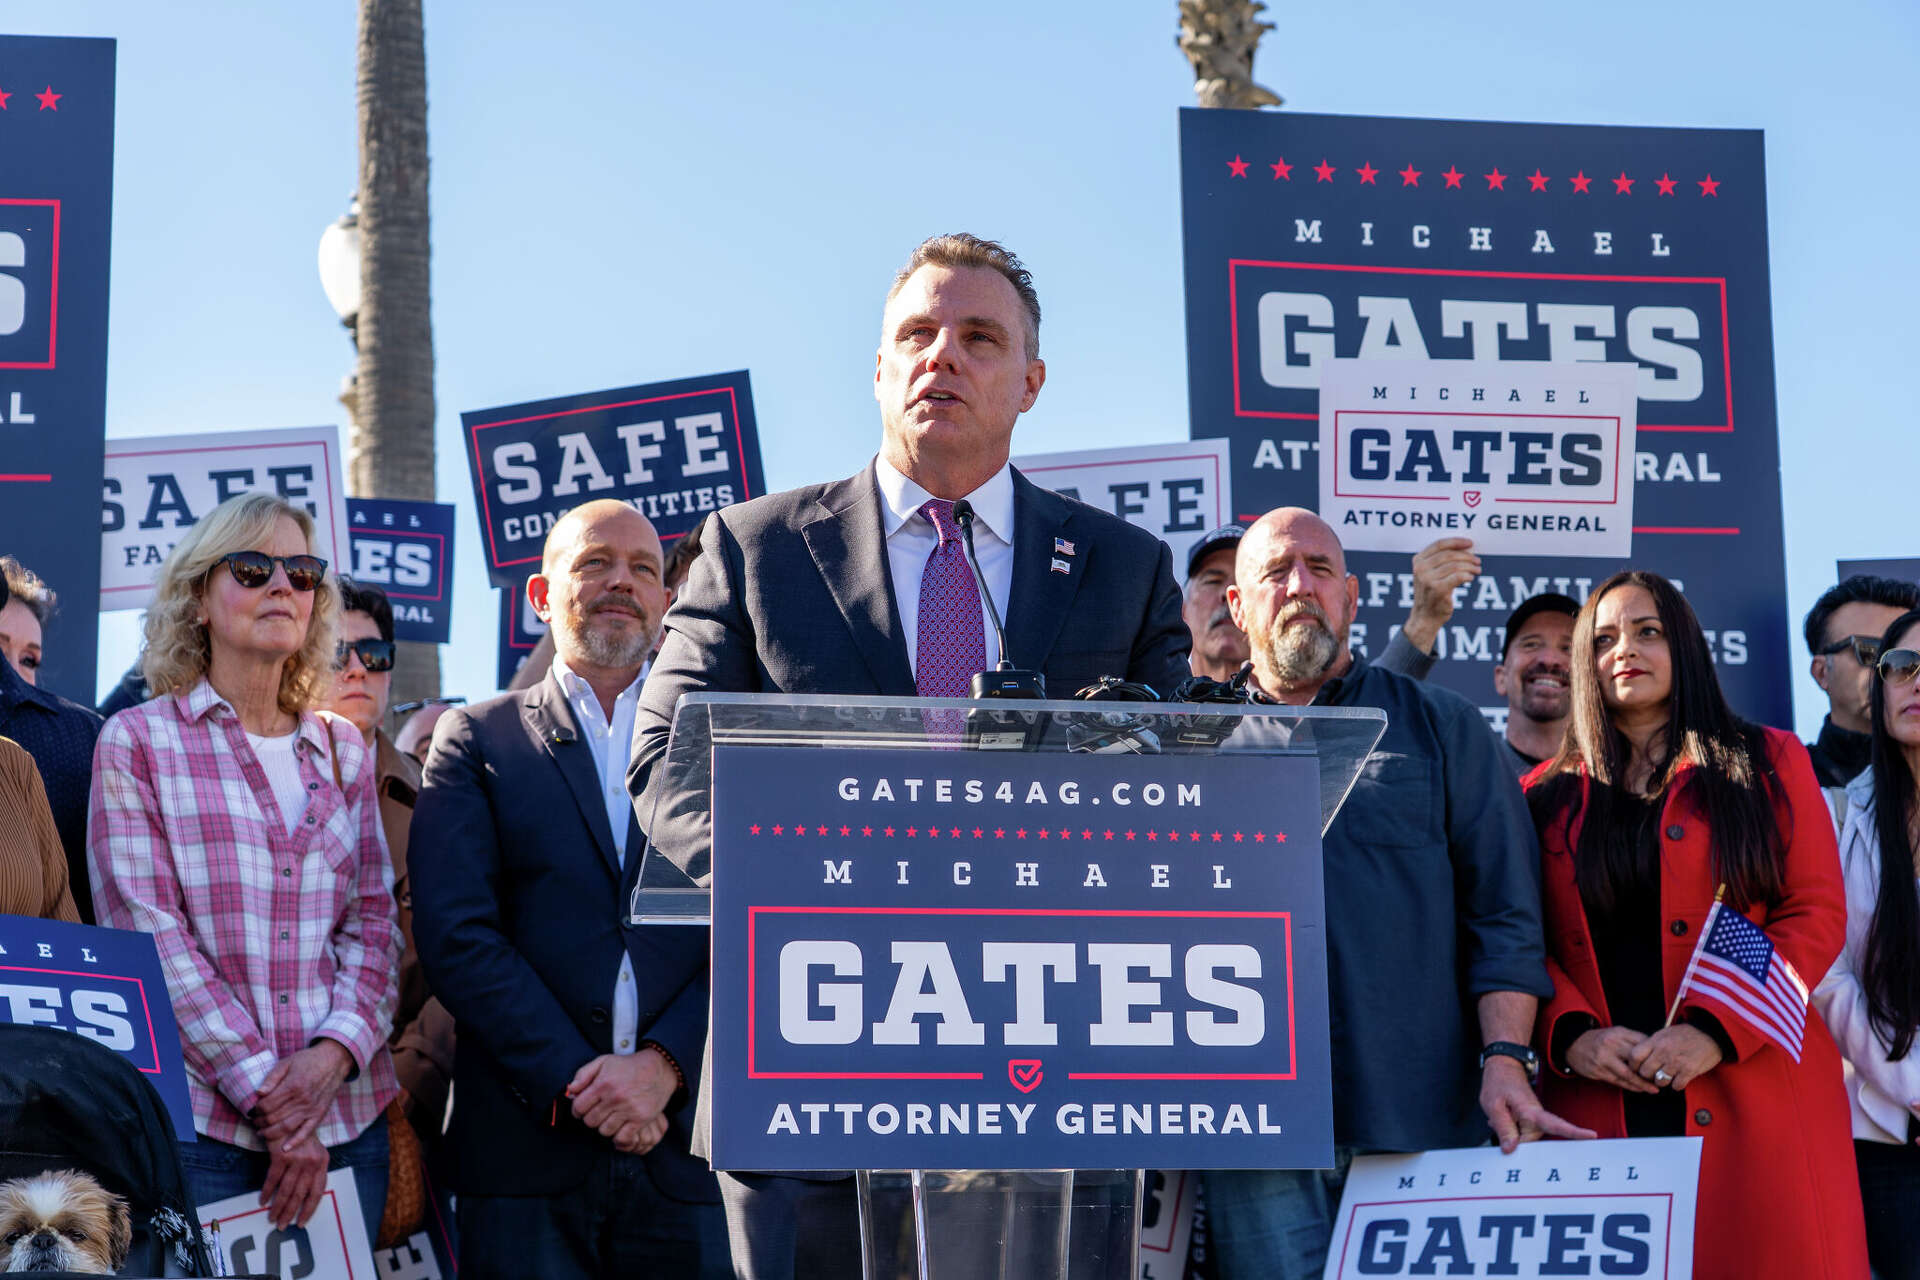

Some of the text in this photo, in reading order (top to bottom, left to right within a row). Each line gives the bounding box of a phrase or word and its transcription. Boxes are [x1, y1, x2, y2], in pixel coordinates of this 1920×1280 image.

[1295, 219, 1670, 256] MICHAEL
[1258, 291, 1704, 402] GATES
[1373, 386, 1590, 403] MICHAEL
[493, 411, 730, 505] SAFE
[1350, 428, 1602, 486] GATES
[1344, 509, 1606, 532] ATTORNEY GENERAL
[838, 777, 1202, 807] GATES4AG.COM
[823, 860, 1232, 889] MICHAEL
[779, 940, 1266, 1047] GATES
[767, 1103, 1281, 1135] ATTORNEY GENERAL
[1397, 1166, 1640, 1190] MICHAEL
[1357, 1213, 1652, 1277] GATES
